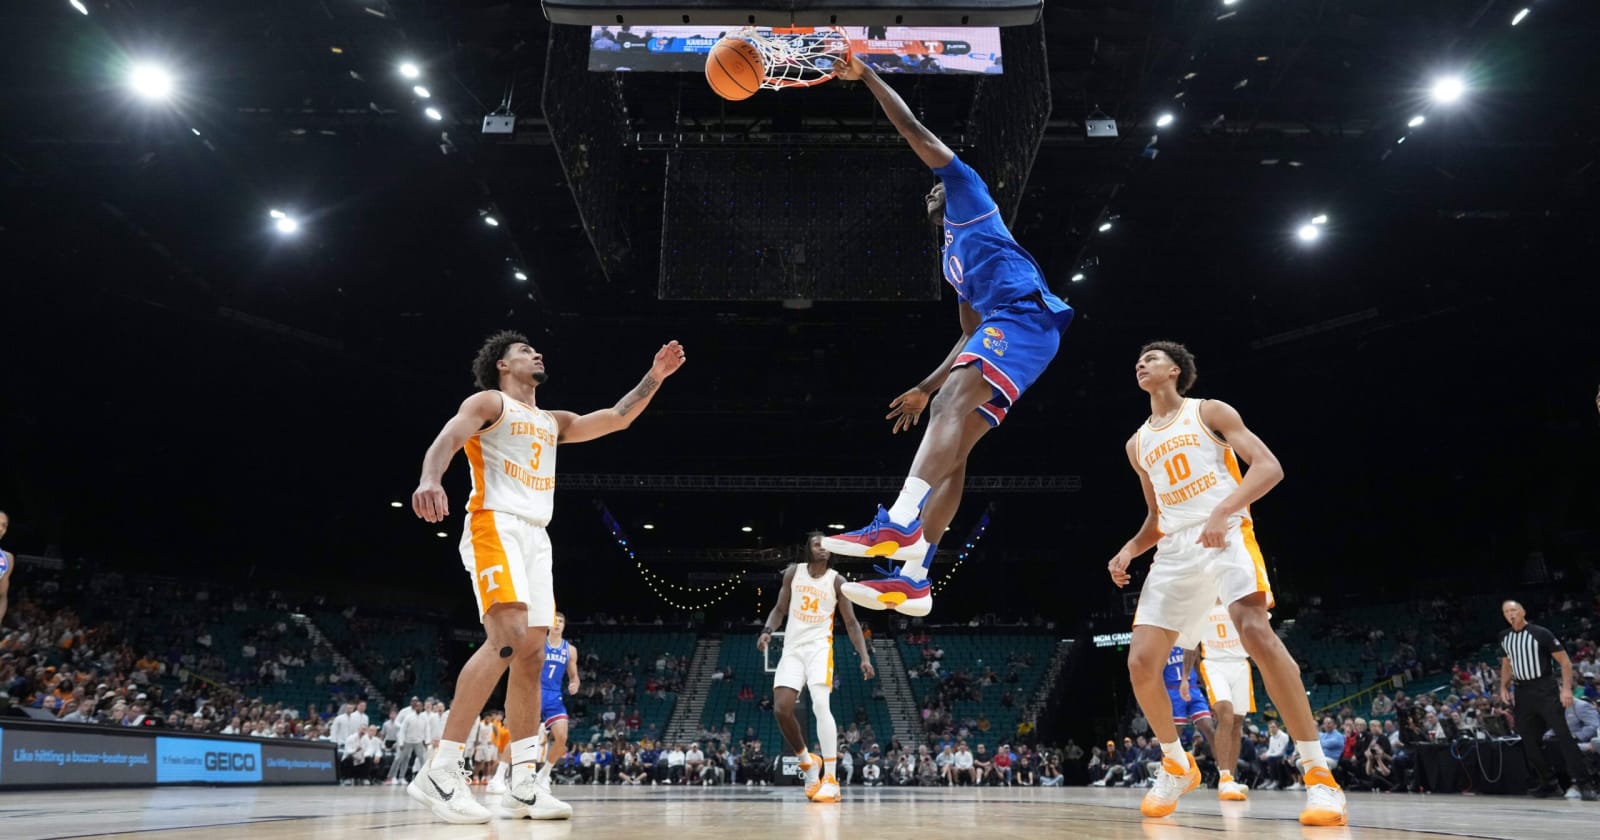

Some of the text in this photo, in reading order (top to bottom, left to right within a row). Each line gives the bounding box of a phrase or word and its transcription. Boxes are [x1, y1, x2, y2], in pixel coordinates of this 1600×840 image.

[529, 441, 543, 471] 3
[1145, 433, 1201, 468] TENNESSEE
[1163, 452, 1192, 486] 10
[1158, 471, 1217, 506] VOLUNTEERS
[480, 564, 504, 593] T
[800, 595, 819, 614] 34
[1216, 623, 1228, 639] 0
[548, 664, 557, 680] 7
[13, 748, 33, 762] Like
[34, 749, 65, 766] hitting
[204, 751, 257, 772] GEICO
